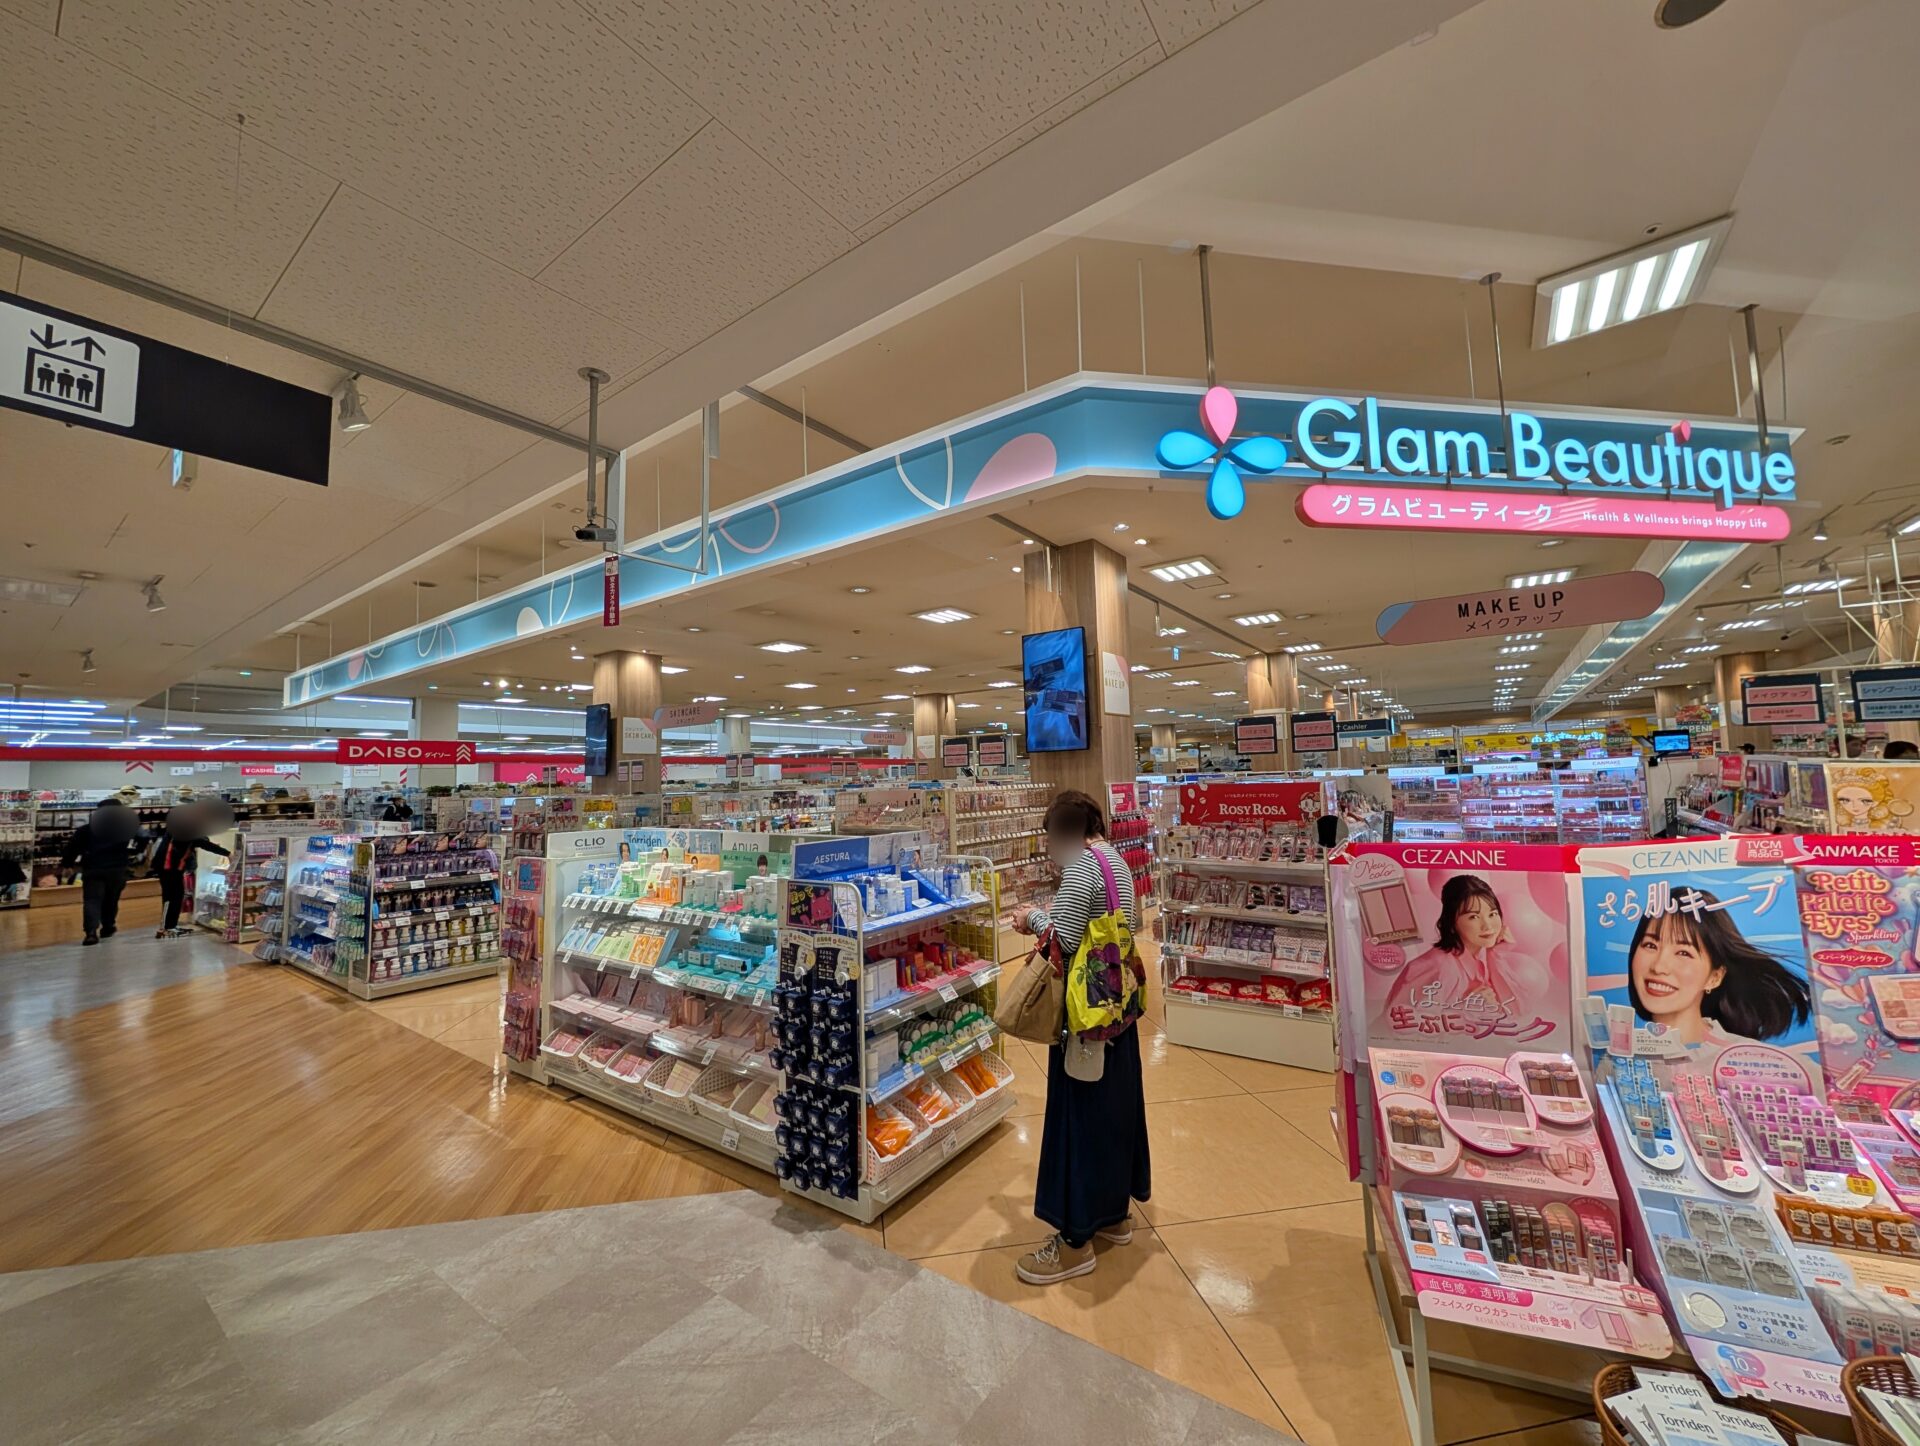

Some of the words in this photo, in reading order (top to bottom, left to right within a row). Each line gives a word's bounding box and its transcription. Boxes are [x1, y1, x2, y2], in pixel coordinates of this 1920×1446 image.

[1296, 396, 1489, 475] Glam
[1508, 411, 1797, 509] Beautique
[1331, 493, 1553, 523] グラムビューティーク
[1582, 511, 1619, 522] Health
[1622, 512, 1631, 522] &
[1634, 512, 1680, 525] Wellness
[1682, 515, 1713, 529] brings
[1715, 516, 1747, 529] Happy
[1749, 518, 1768, 529] Life
[1457, 596, 1521, 619] MAKE
[1533, 590, 1565, 609] UP
[1464, 609, 1565, 633] メイクアップ
[1751, 690, 1809, 699] メイクアップ
[1342, 723, 1368, 731] Cashier
[348, 746, 422, 758] DAISO
[1219, 803, 1252, 815] ROSY
[1252, 803, 1288, 815] ROSA
[574, 836, 606, 848] CLIO
[627, 834, 662, 848] Torriden
[732, 839, 760, 851] Anua
[1745, 840, 1783, 850] TVCM
[814, 851, 851, 865] AESTURA
[1402, 848, 1507, 867] CEZANNE
[1632, 846, 1729, 870] CEZANNE
[1803, 845, 1900, 858] ANMAKE
[1355, 860, 1387, 879] New
[1368, 867, 1396, 880] color
[1807, 869, 1891, 893] Petit
[1597, 875, 1787, 928] さら肌キープ
[1800, 891, 1896, 915] Palette
[1802, 911, 1880, 938] Eyes
[1847, 928, 1901, 944] Sparkling
[1817, 952, 1888, 963] スパークリングタイプ
[1730, 1354, 1750, 1373] 10
[1647, 1380, 1702, 1398] Torriden
[1656, 1412, 1715, 1435] Torriden
[1711, 1409, 1772, 1434] Torriden
